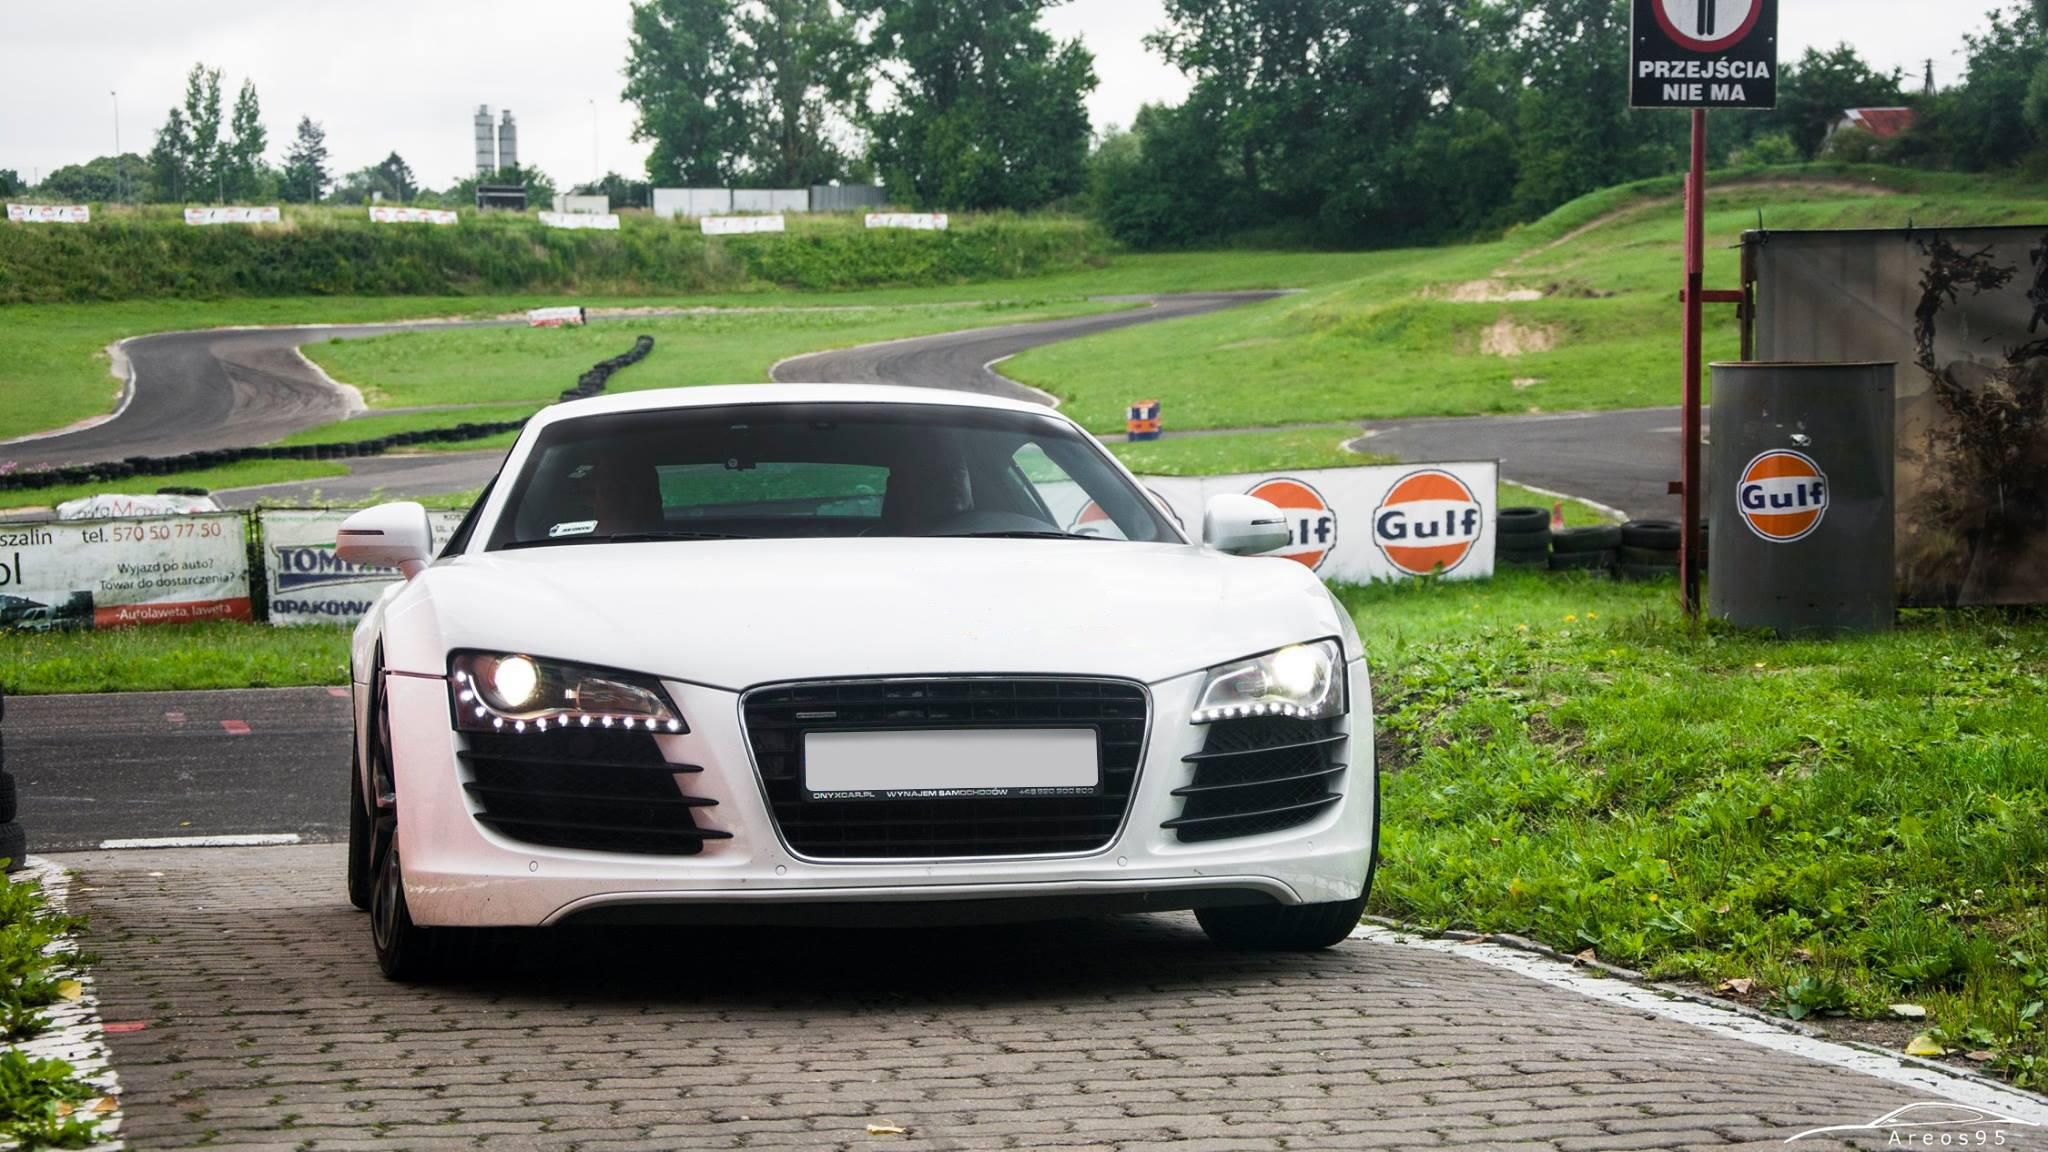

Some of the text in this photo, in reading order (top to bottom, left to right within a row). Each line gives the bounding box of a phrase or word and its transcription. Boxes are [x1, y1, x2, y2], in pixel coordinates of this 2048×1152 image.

[1638, 56, 1770, 79] PRZEJŚCIA
[1662, 83, 1746, 101] NIE MA
[1741, 482, 1825, 510] Gulf
[82, 527, 108, 543] tel.
[112, 525, 144, 542] 570
[150, 524, 170, 541] 50
[175, 523, 195, 538] 77
[200, 521, 221, 538] 50
[1287, 516, 1333, 546] lf
[1376, 508, 1479, 541] Gulf
[117, 558, 214, 578] Wyjazd po auto?
[101, 571, 235, 591] Towar do dostarczenia?
[813, 791, 876, 799] ONYXCAR.PL
[886, 789, 937, 798] WYNAJEM
[938, 786, 1008, 797] SAMOCHODÓW
